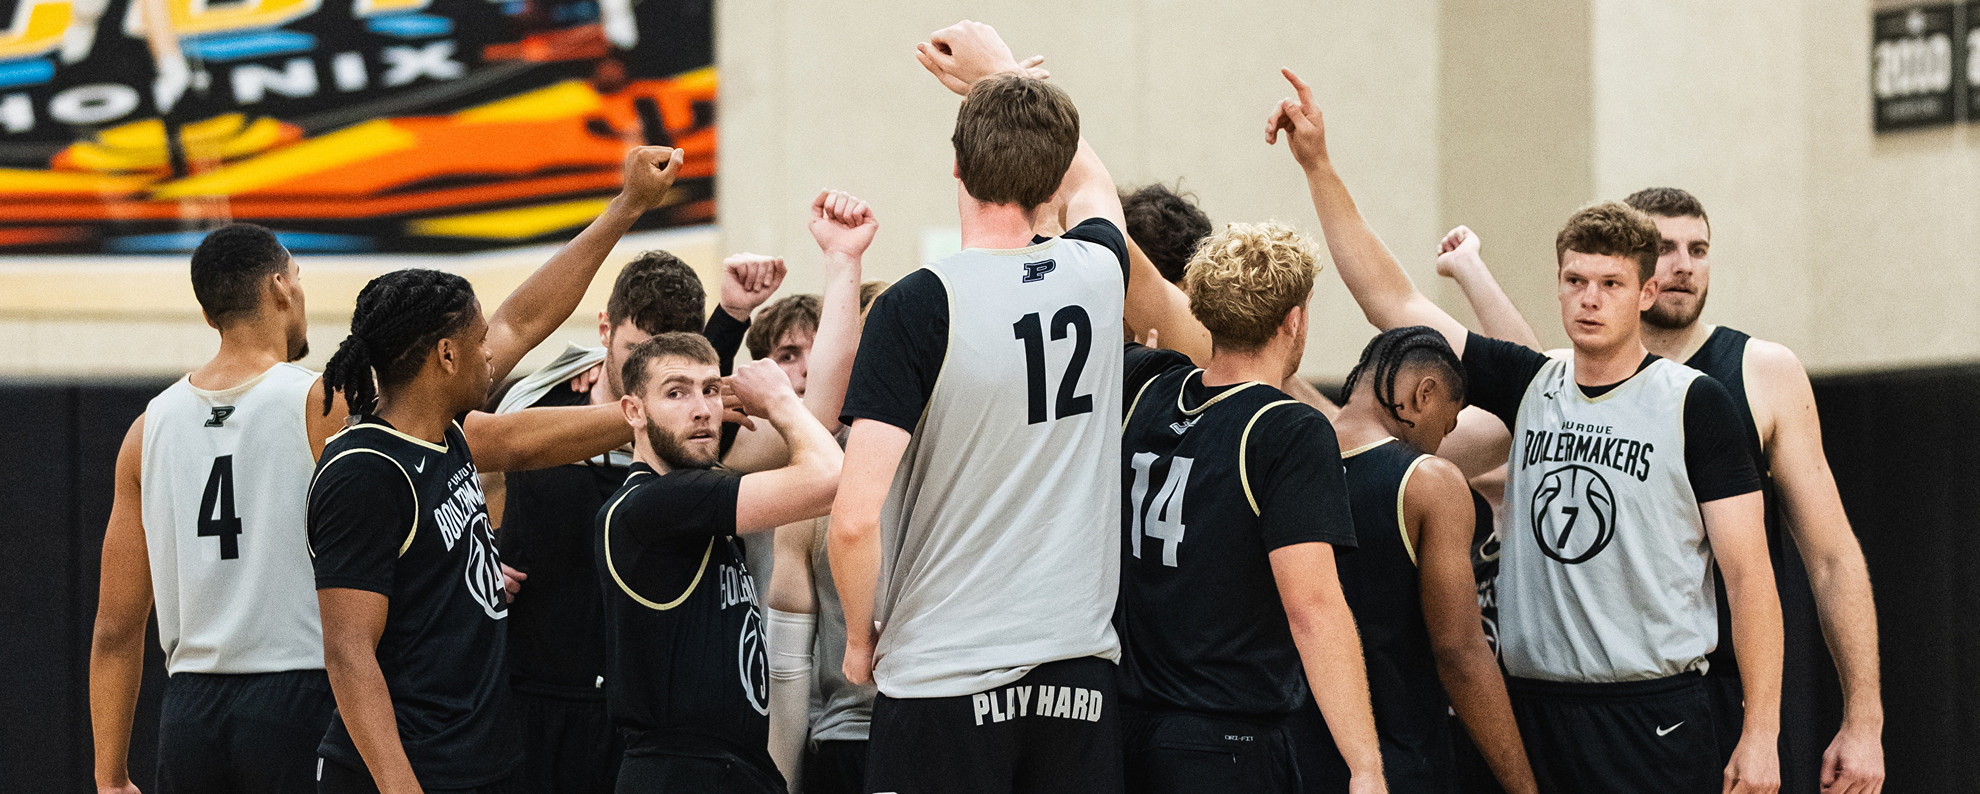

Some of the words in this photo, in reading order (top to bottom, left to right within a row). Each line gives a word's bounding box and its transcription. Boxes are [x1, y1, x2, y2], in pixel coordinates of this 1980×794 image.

[0, 40, 466, 131] ONIX
[1022, 258, 1056, 283] P
[1012, 304, 1093, 425] 12
[204, 405, 236, 428] P
[197, 454, 242, 560] 4
[1131, 451, 1195, 567] 14
[1557, 506, 1579, 549] 7
[972, 685, 1032, 726] PLAY
[1036, 685, 1103, 722] HARD
